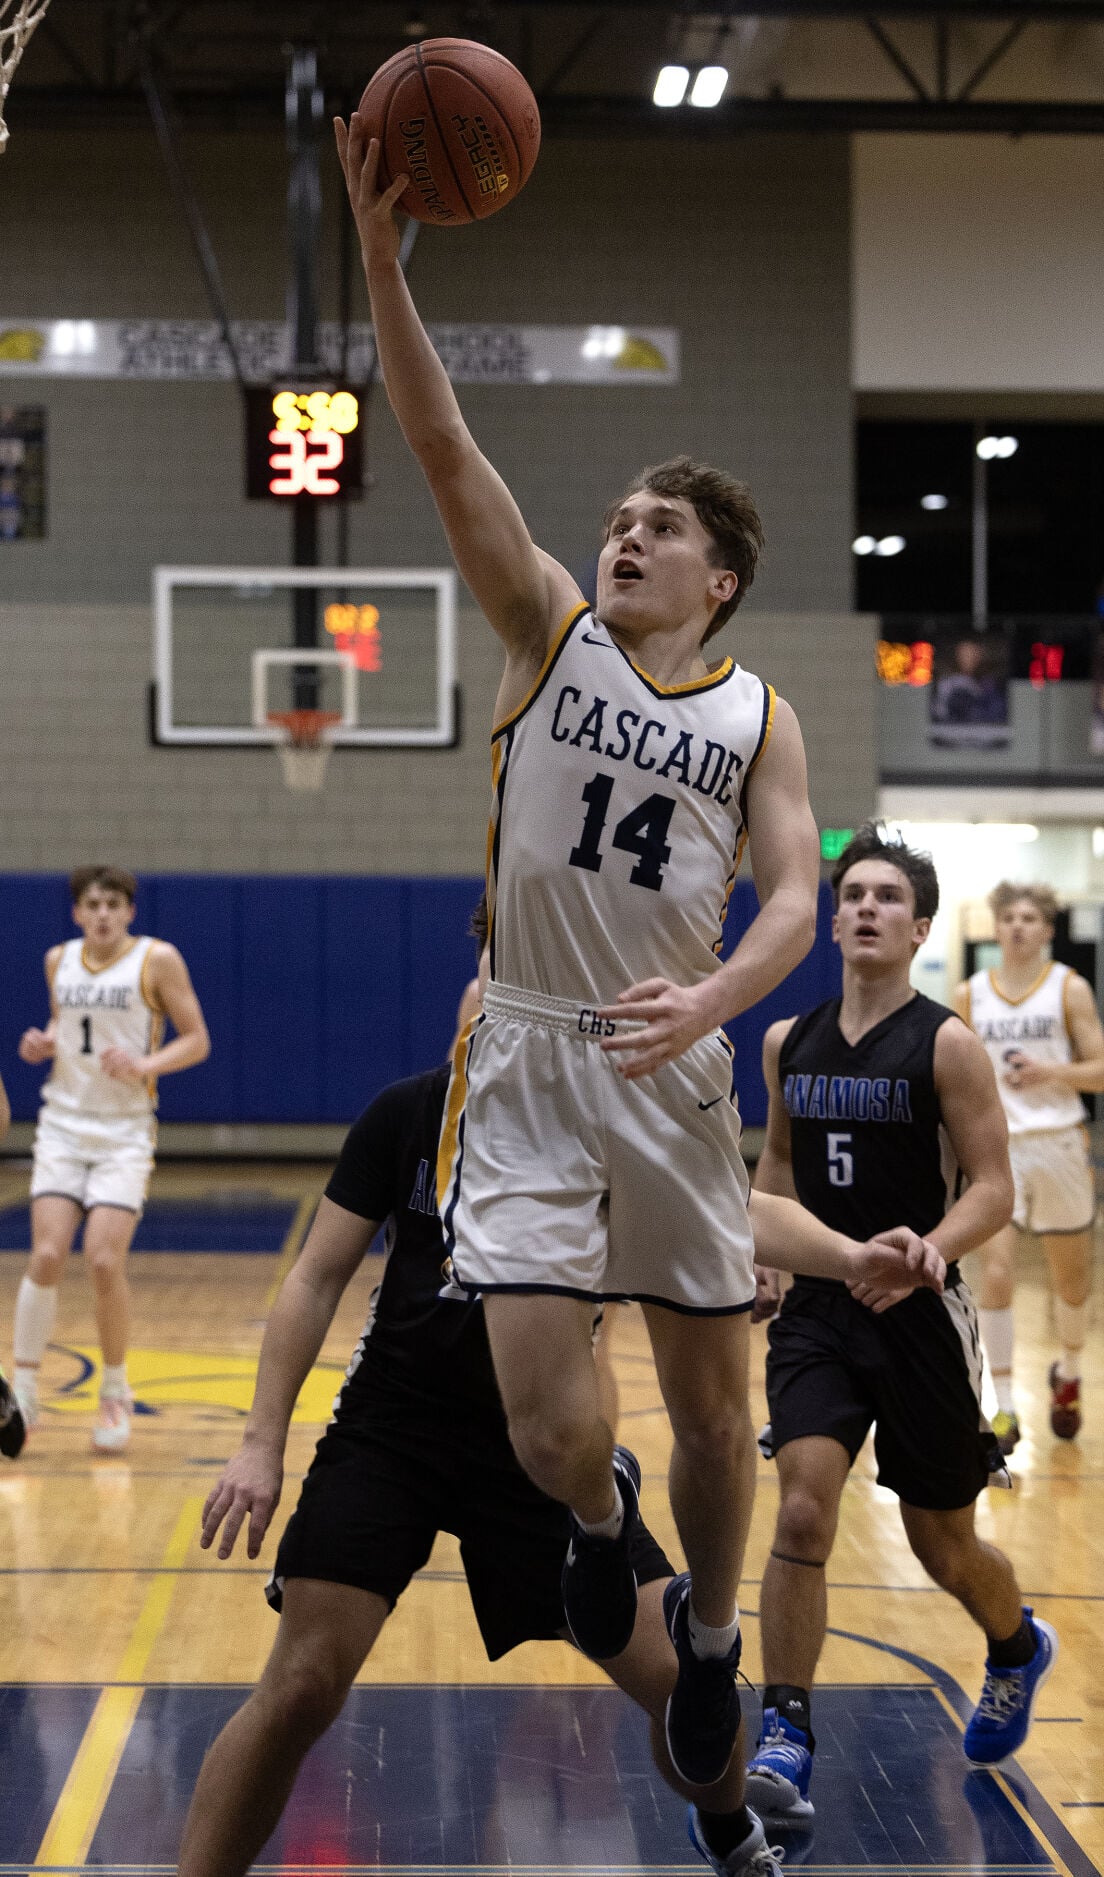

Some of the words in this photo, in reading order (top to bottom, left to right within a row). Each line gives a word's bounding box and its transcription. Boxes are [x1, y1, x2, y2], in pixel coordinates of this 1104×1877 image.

[269, 429, 343, 494] 32
[550, 685, 743, 805] CASCADE
[568, 772, 677, 892] 14
[80, 1015, 93, 1055] 1
[578, 1009, 616, 1036] CHS
[783, 1073, 913, 1124] ANAMOSA
[827, 1132, 853, 1187] 5
